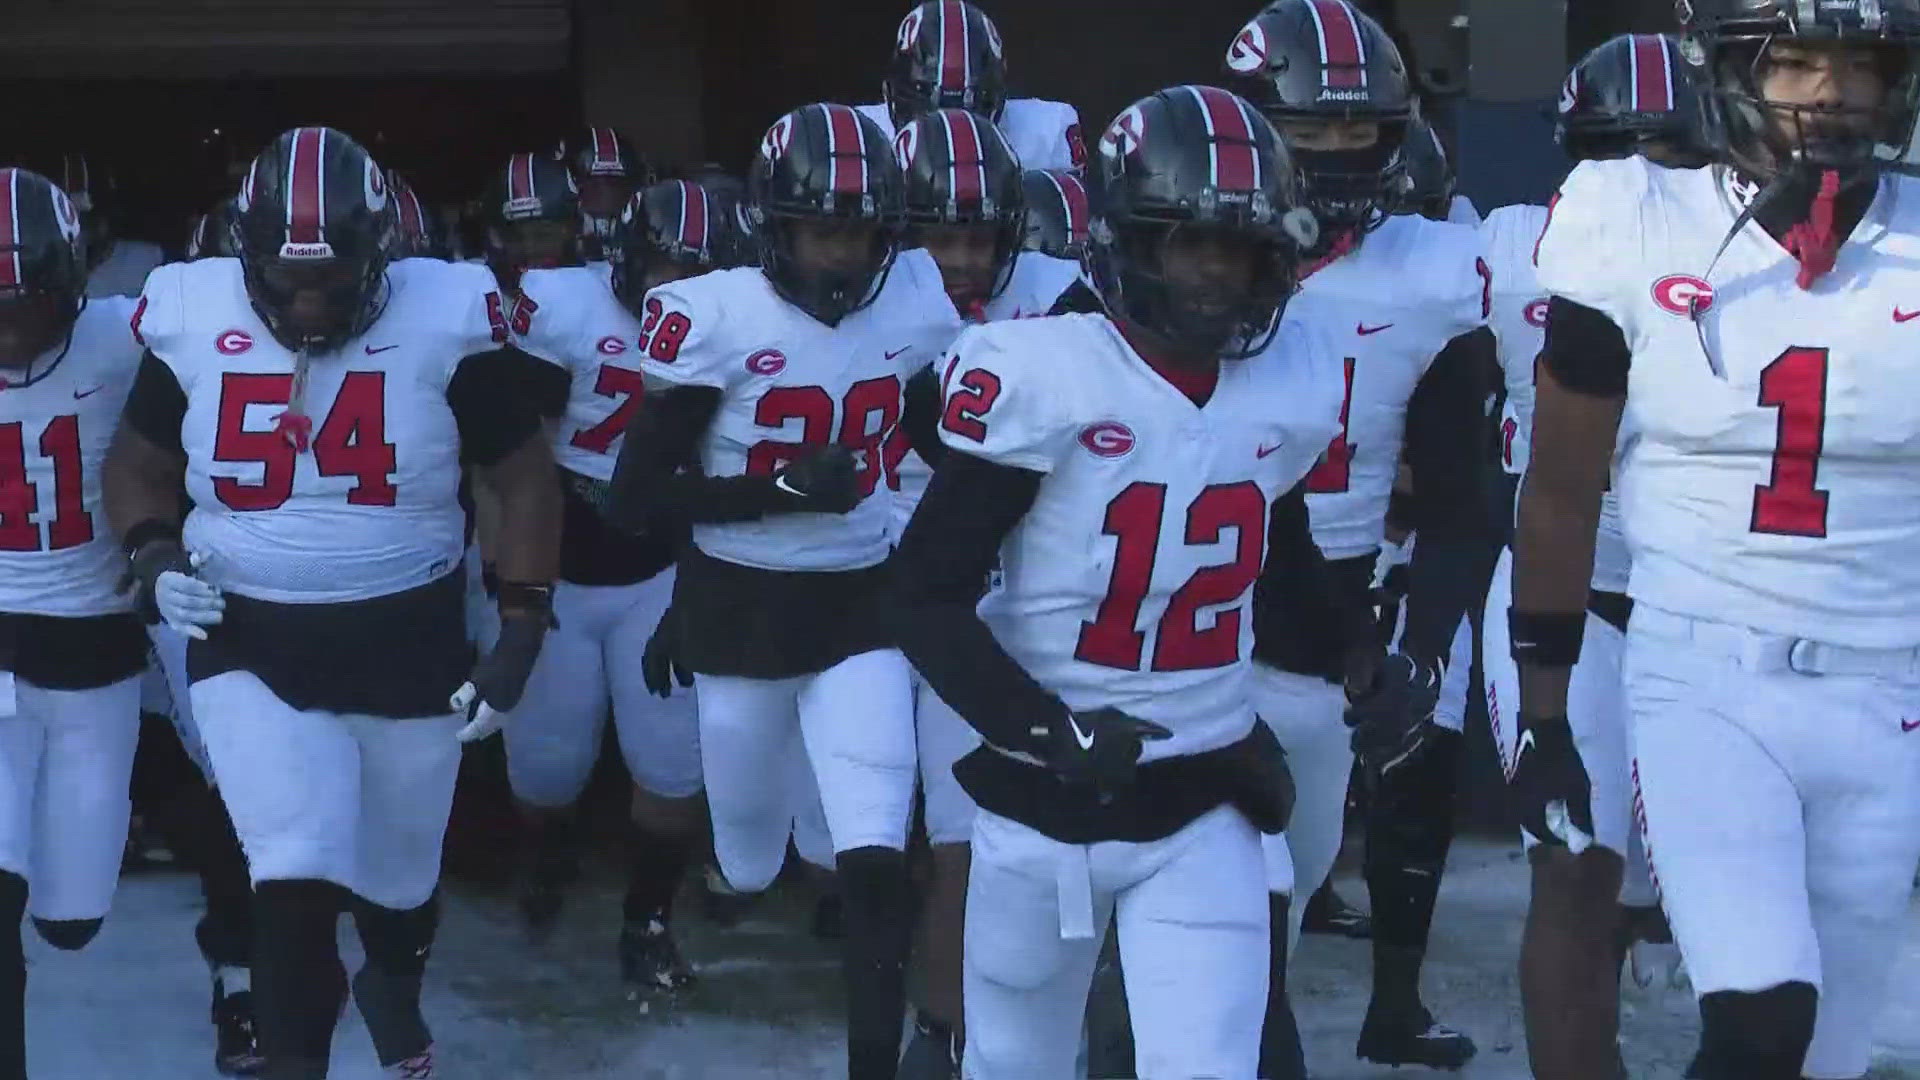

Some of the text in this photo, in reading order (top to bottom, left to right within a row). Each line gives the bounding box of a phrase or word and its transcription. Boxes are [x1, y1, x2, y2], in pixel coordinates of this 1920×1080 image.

[210, 370, 398, 512] 54
[569, 364, 645, 456] 7
[1749, 344, 1830, 539] 1
[1073, 479, 1267, 673] 12
